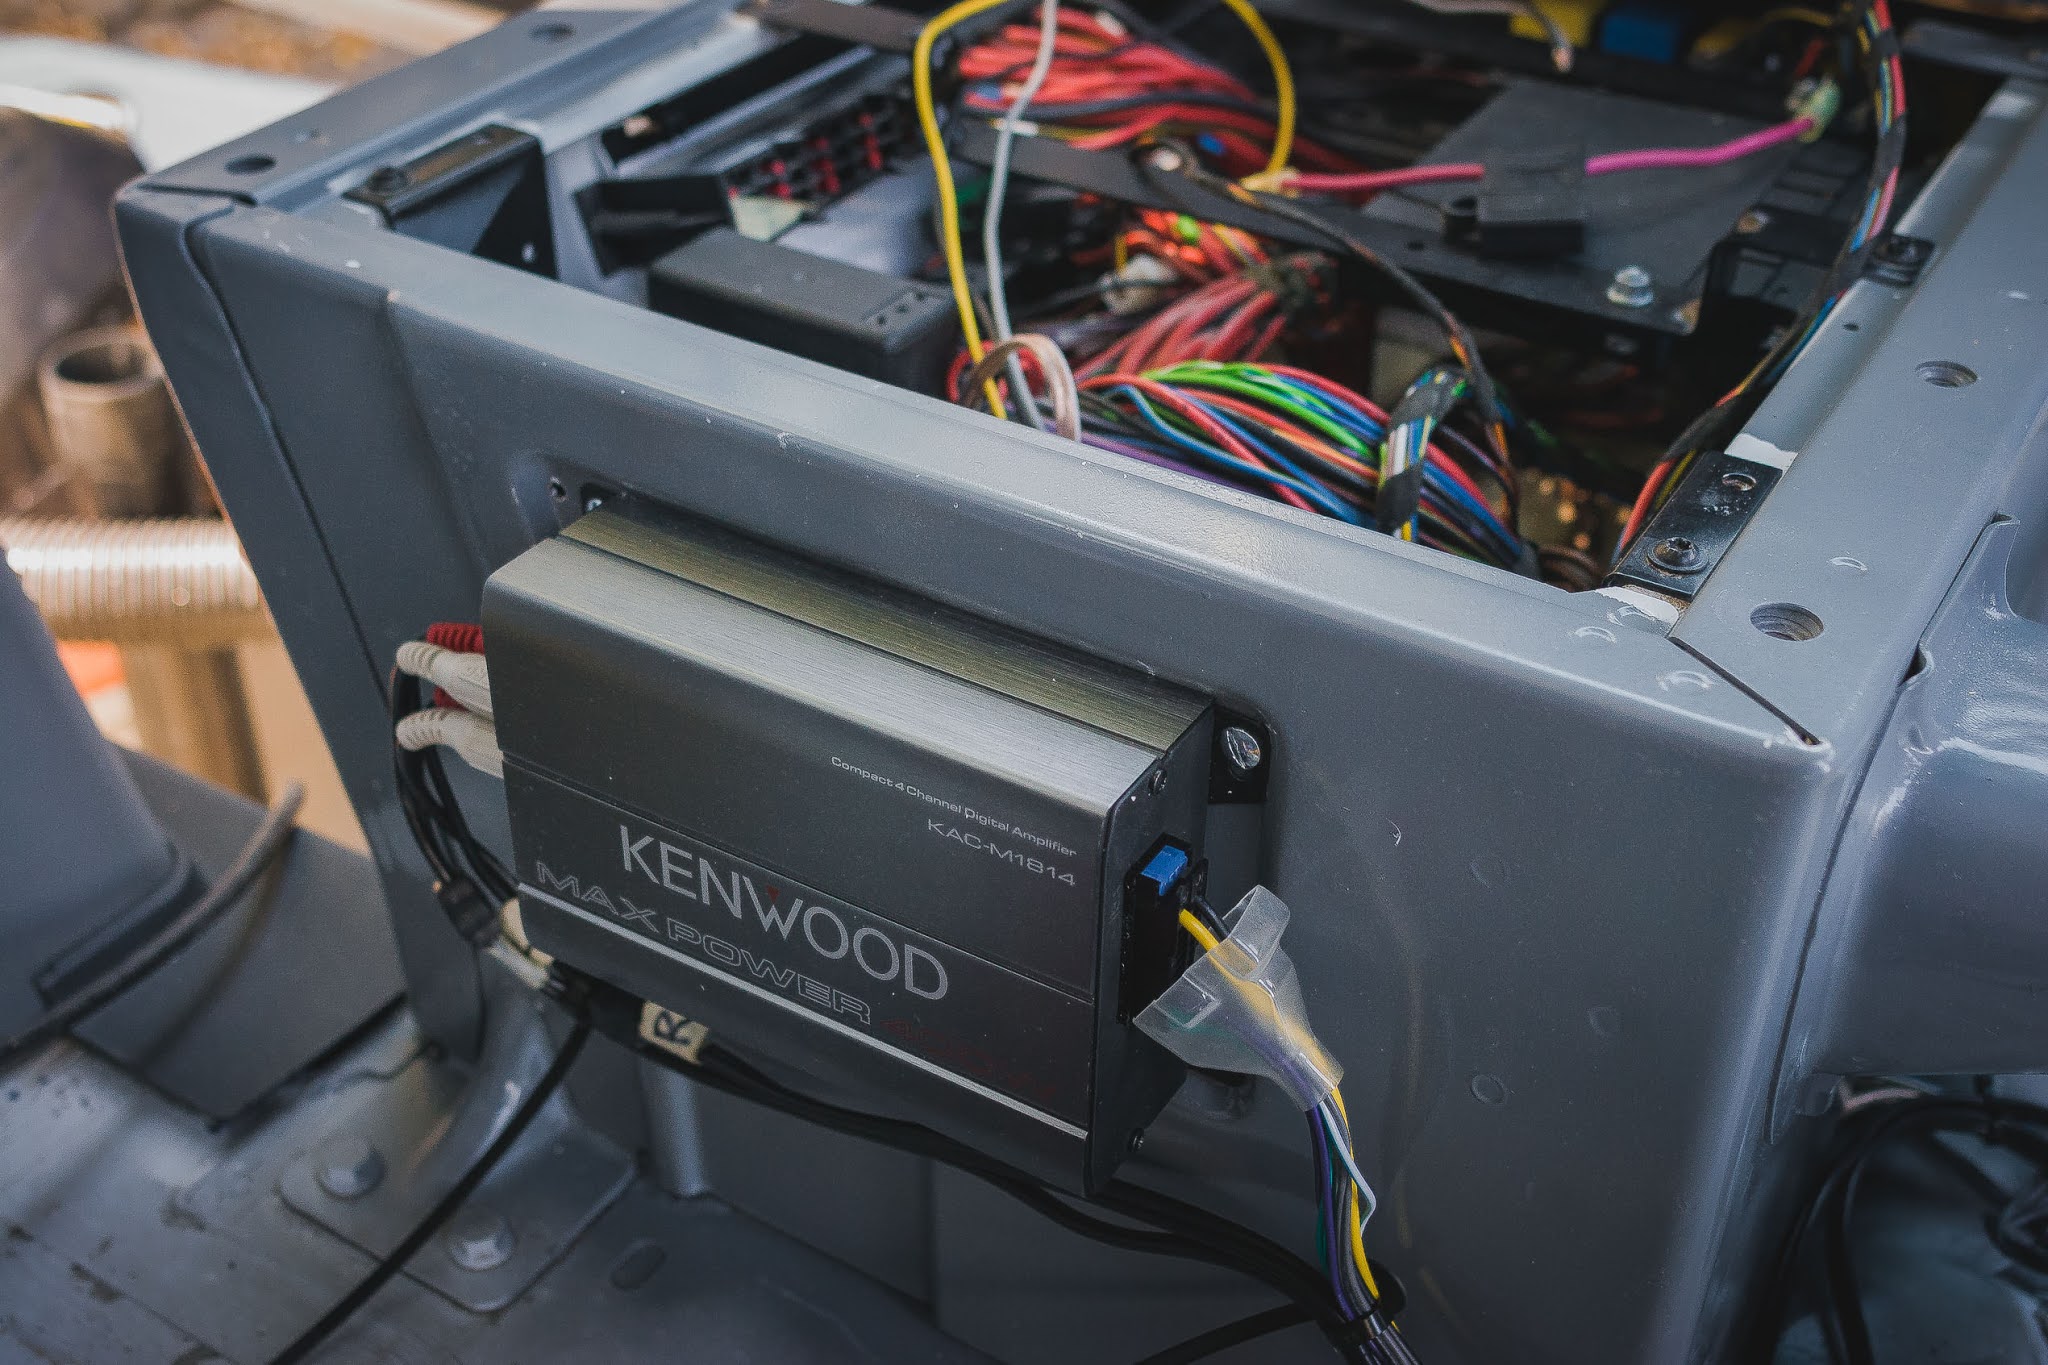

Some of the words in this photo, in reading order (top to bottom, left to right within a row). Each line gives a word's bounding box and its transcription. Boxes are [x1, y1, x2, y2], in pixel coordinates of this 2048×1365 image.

[831, 756, 893, 787] Compact
[895, 781, 905, 792] 4
[906, 785, 962, 814] Channel
[964, 807, 1009, 834] Digital
[1011, 826, 1078, 858] Amplifier
[928, 818, 1076, 887] KAC-M1814
[536, 860, 660, 933] MAX
[666, 917, 871, 1025] POWER
[619, 824, 948, 1000] KENWOOD
